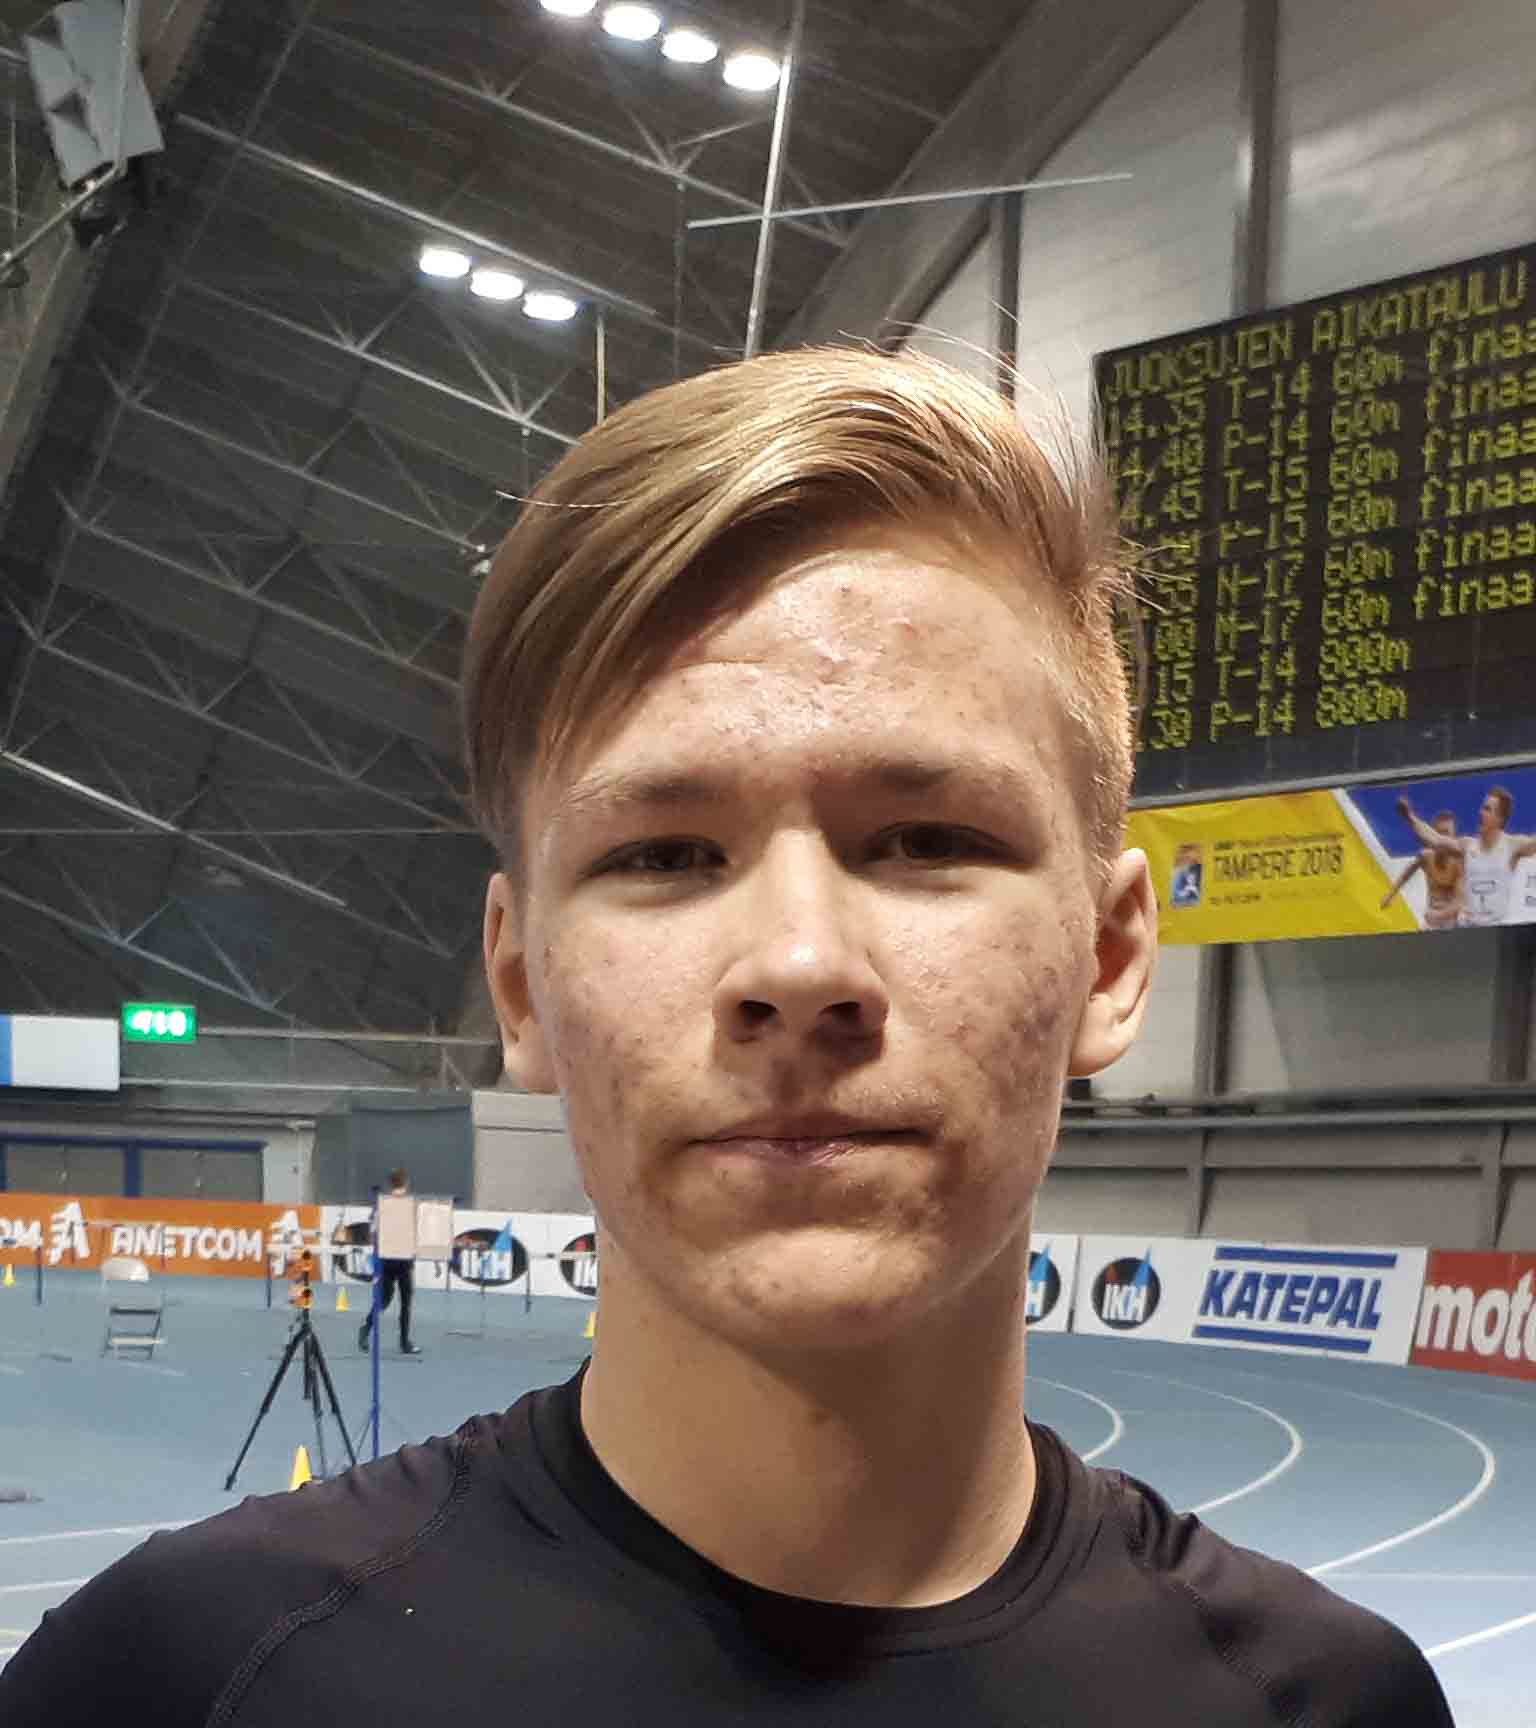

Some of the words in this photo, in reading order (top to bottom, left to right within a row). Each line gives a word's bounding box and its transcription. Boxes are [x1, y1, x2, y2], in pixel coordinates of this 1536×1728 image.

[1313, 260, 1528, 353] AIKATAULU
[1225, 359, 1312, 418] T-14
[1222, 408, 1311, 470] P-14
[1224, 453, 1310, 513] T-15
[1213, 645, 1299, 702] T-14
[1209, 692, 1296, 744] P-14
[1214, 848, 1296, 880] TAMPERE
[1199, 1269, 1383, 1331] KATEPAL
